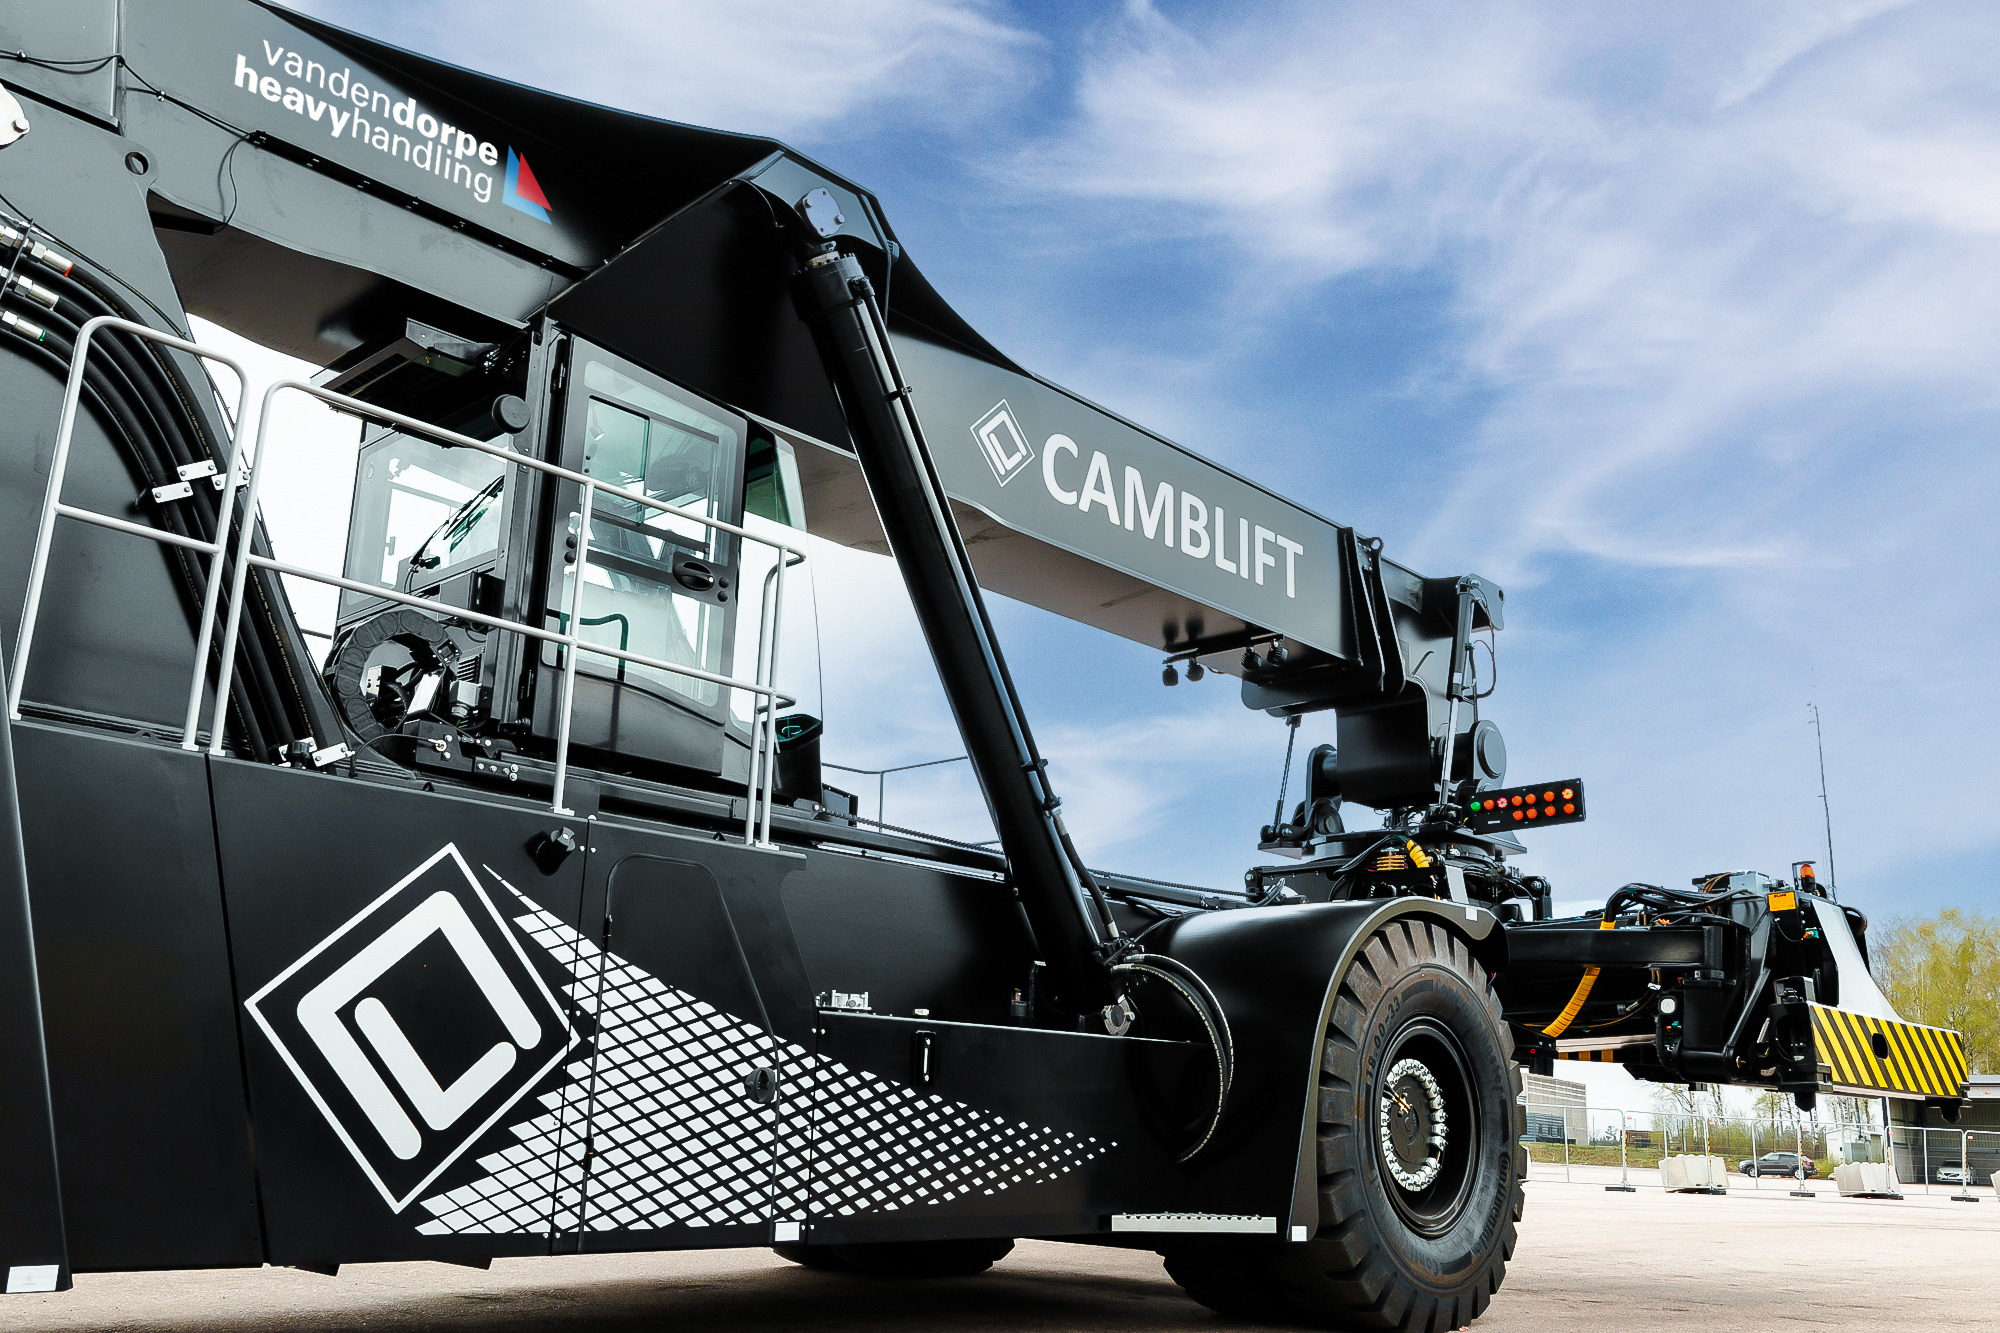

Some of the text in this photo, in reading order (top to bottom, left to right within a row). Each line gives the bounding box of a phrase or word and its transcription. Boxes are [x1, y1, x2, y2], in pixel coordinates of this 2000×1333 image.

[234, 53, 493, 203] heavyhandling
[263, 39, 498, 166] vandendorpe
[1042, 433, 1303, 598] CAMBLIFT
[1366, 995, 1400, 1079] 18.00-33
[1480, 1151, 1510, 1251] Continental
